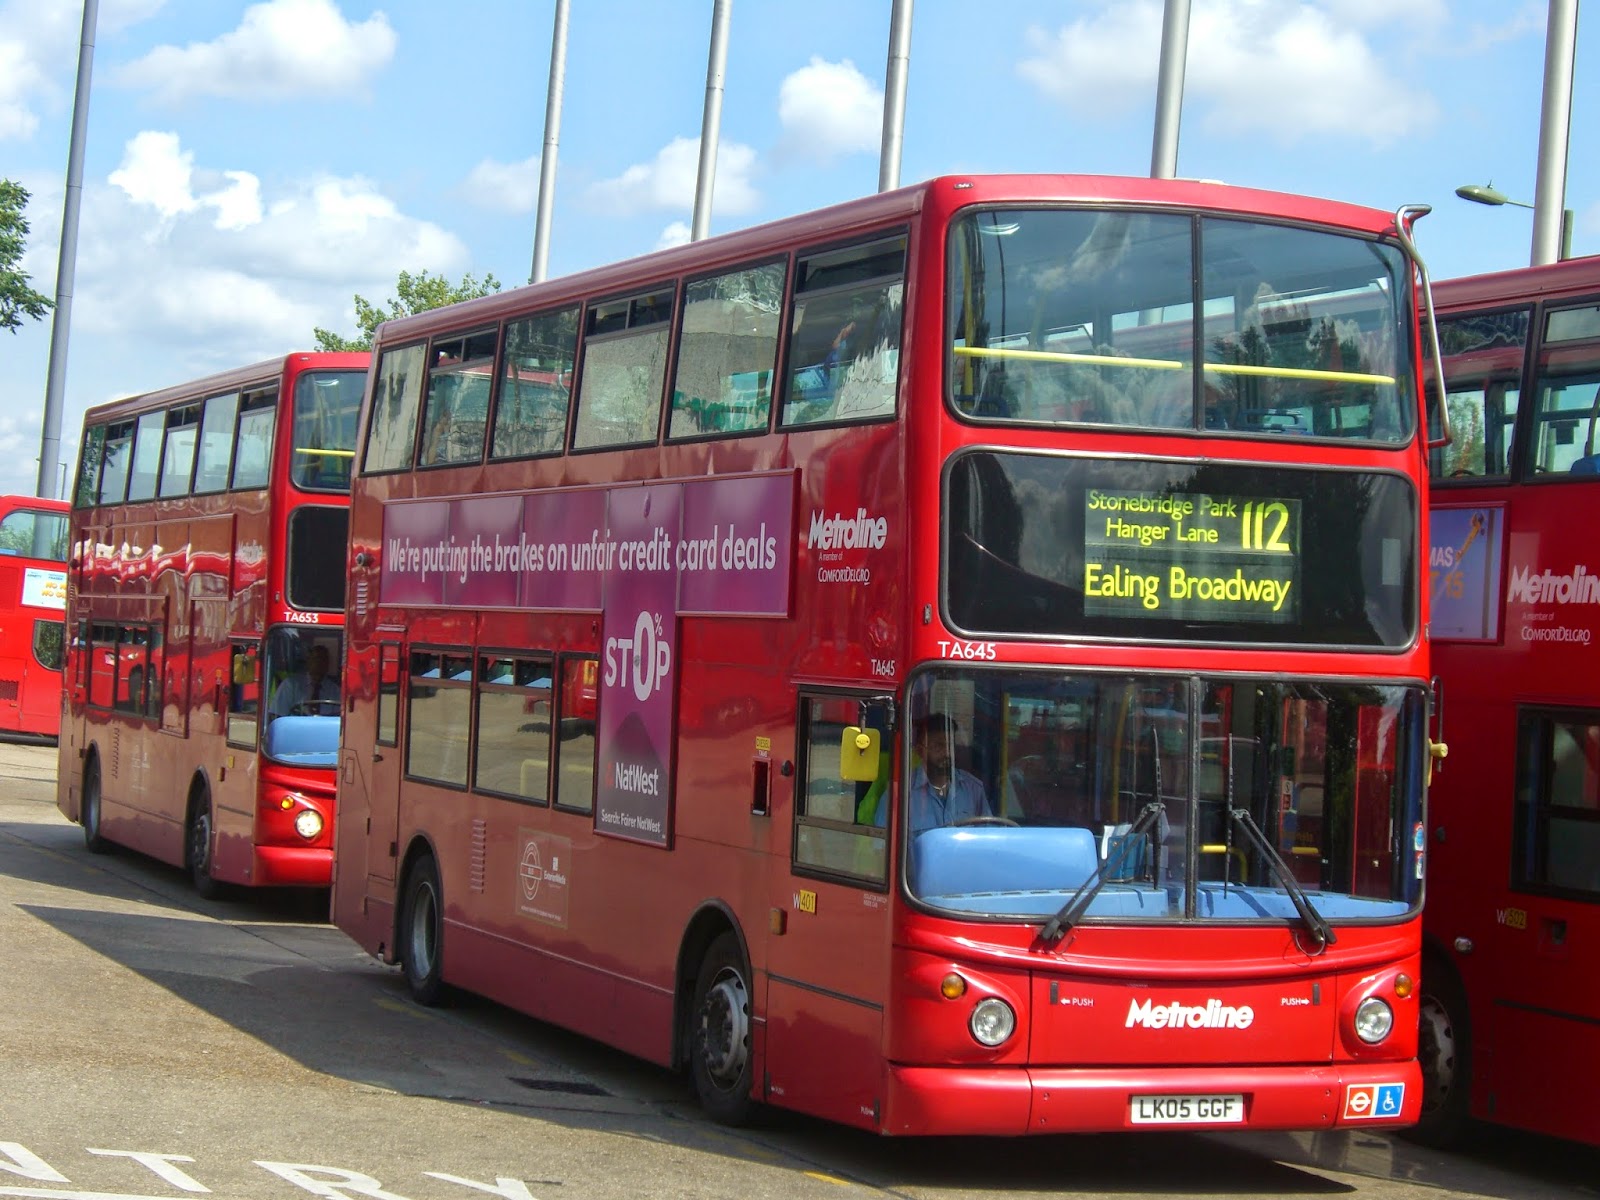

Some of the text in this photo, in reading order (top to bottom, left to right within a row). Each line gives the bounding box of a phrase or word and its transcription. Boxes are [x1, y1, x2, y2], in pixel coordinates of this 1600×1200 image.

[1088, 490, 1237, 520] Stonebridge Park
[807, 507, 888, 550] Metroline
[1106, 518, 1219, 545] Hanger Lane
[1242, 501, 1291, 552] 112
[389, 523, 777, 584] We're putting the brakes on unfair credit card deals
[1085, 563, 1291, 611] Ealing Broadway
[1507, 564, 1600, 604] Metrolin
[283, 611, 319, 624] TA653
[938, 641, 997, 660] TA645
[871, 659, 895, 676] TA645
[616, 762, 659, 796] NatWest
[601, 809, 661, 833] Search: Fairer NatWest
[1072, 997, 1094, 1007] PUSH
[1125, 997, 1254, 1029] Metroline
[1281, 997, 1301, 1006] PUSH
[1140, 1098, 1235, 1119] LK05 GGF
